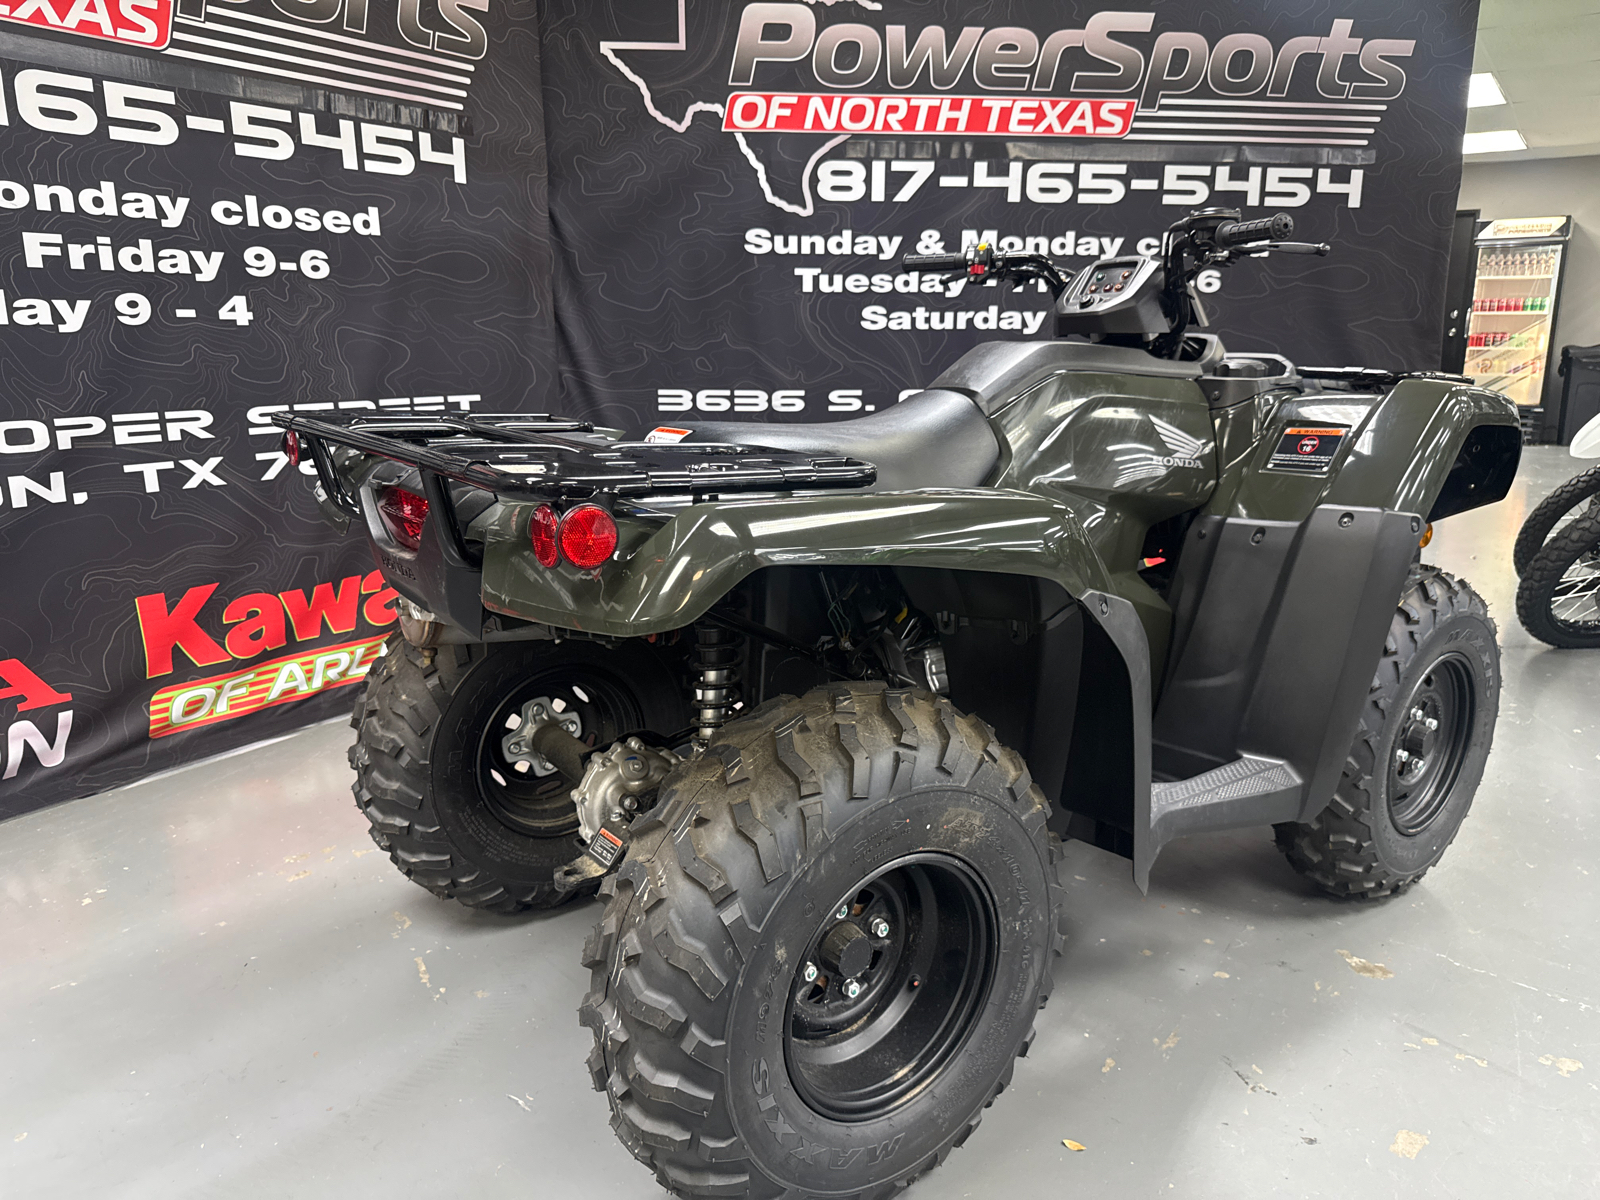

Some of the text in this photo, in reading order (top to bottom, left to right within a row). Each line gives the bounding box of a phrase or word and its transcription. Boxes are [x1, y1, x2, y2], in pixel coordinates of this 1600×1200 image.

[728, 3, 1416, 113] PowerSports
[0, 67, 467, 184] 65-5454
[732, 95, 1128, 136] OF NORTH TEXAS
[816, 159, 1364, 209] 817-465-5454
[210, 195, 381, 236] closed
[22, 231, 331, 282] Friday 9-6
[744, 227, 903, 260] Sunday
[915, 229, 946, 256] &
[794, 267, 967, 298] Tuesday
[114, 292, 152, 326] 9
[175, 308, 197, 318] -
[218, 295, 254, 326] 4
[860, 306, 1047, 335] Saturday
[657, 389, 806, 412] 3636
[827, 389, 876, 412] S.
[122, 456, 228, 494] TX
[1152, 456, 1205, 470] HONDA
[171, 674, 257, 725] OF
[752, 1056, 906, 1170] MAXXIS
